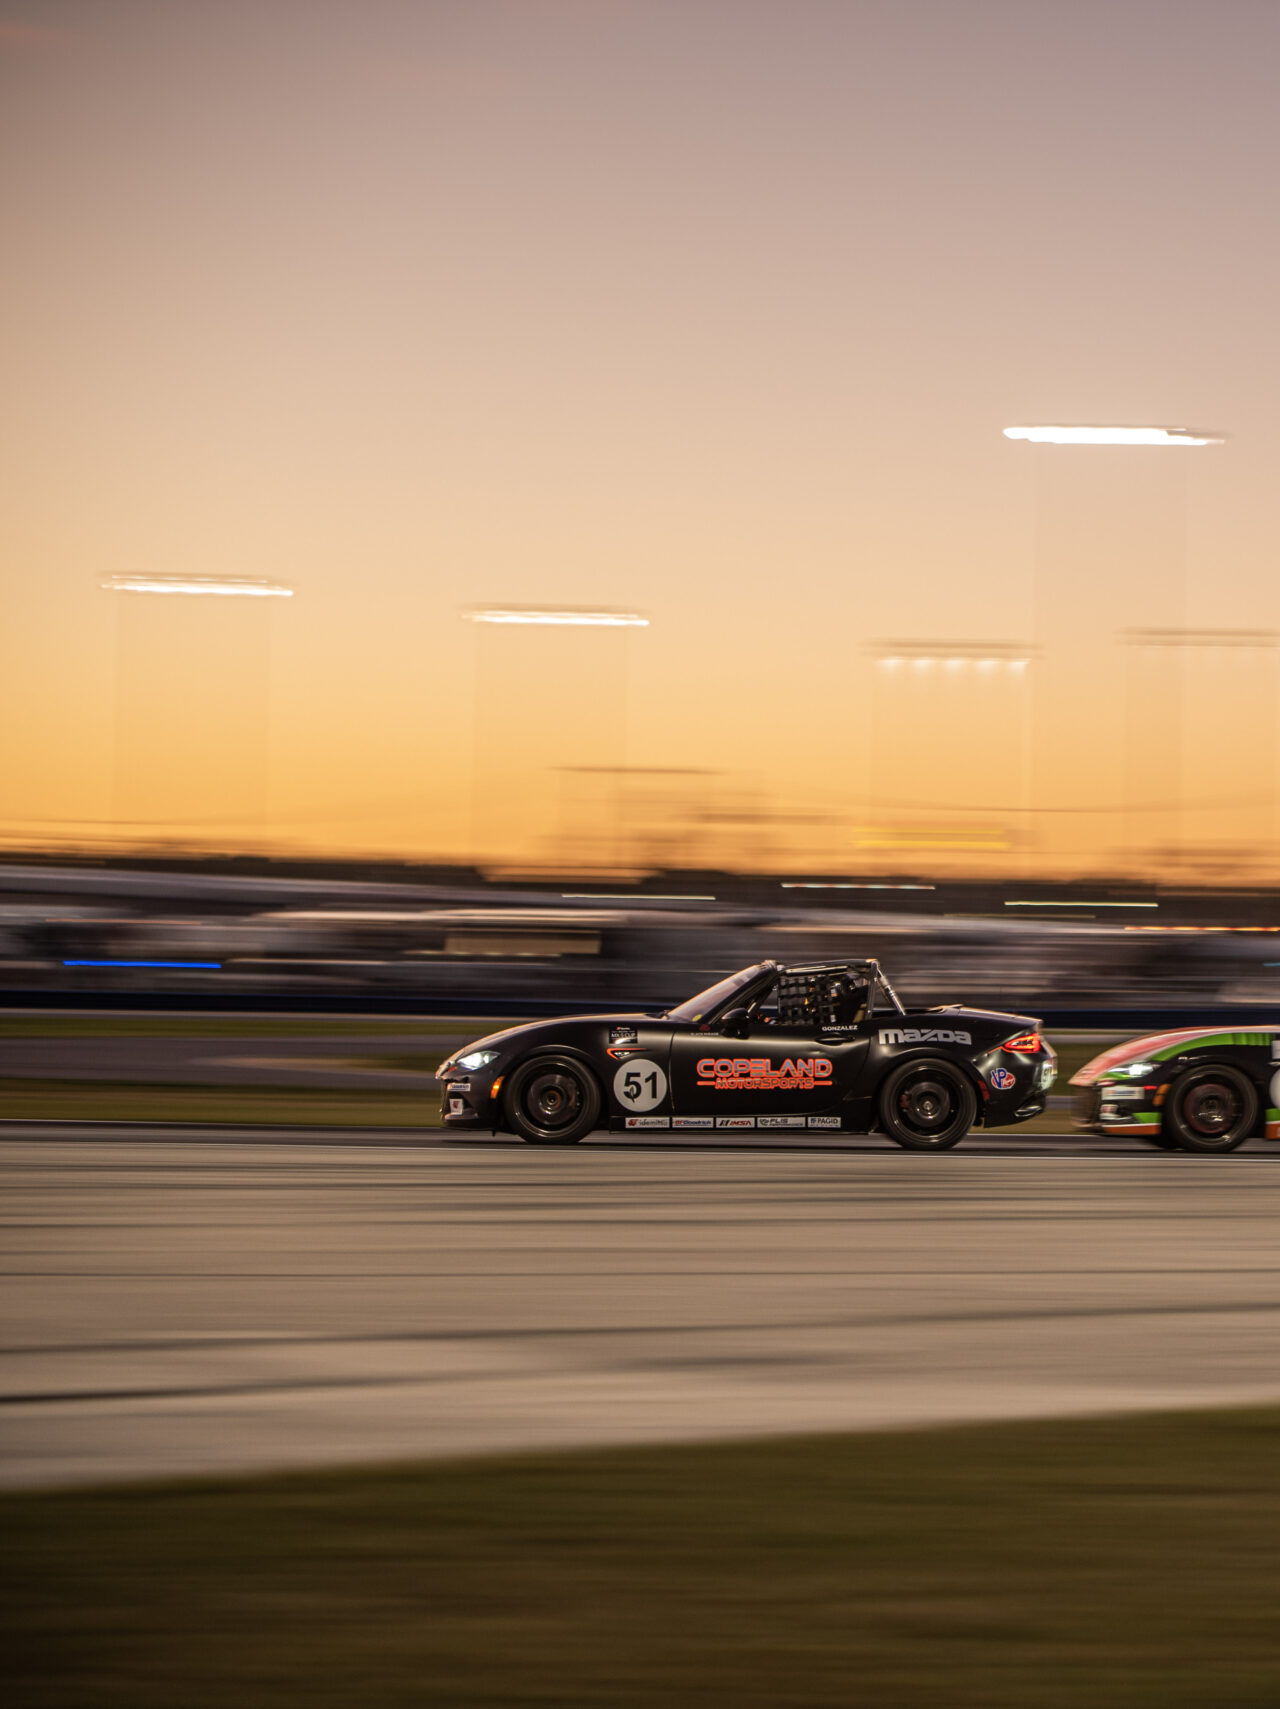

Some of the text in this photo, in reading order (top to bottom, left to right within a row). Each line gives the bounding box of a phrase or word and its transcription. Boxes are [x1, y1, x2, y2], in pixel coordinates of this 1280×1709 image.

[696, 1058, 833, 1078] COPELAND
[624, 1072, 657, 1100] 51
[714, 1077, 815, 1090] MOTORSPORTS
